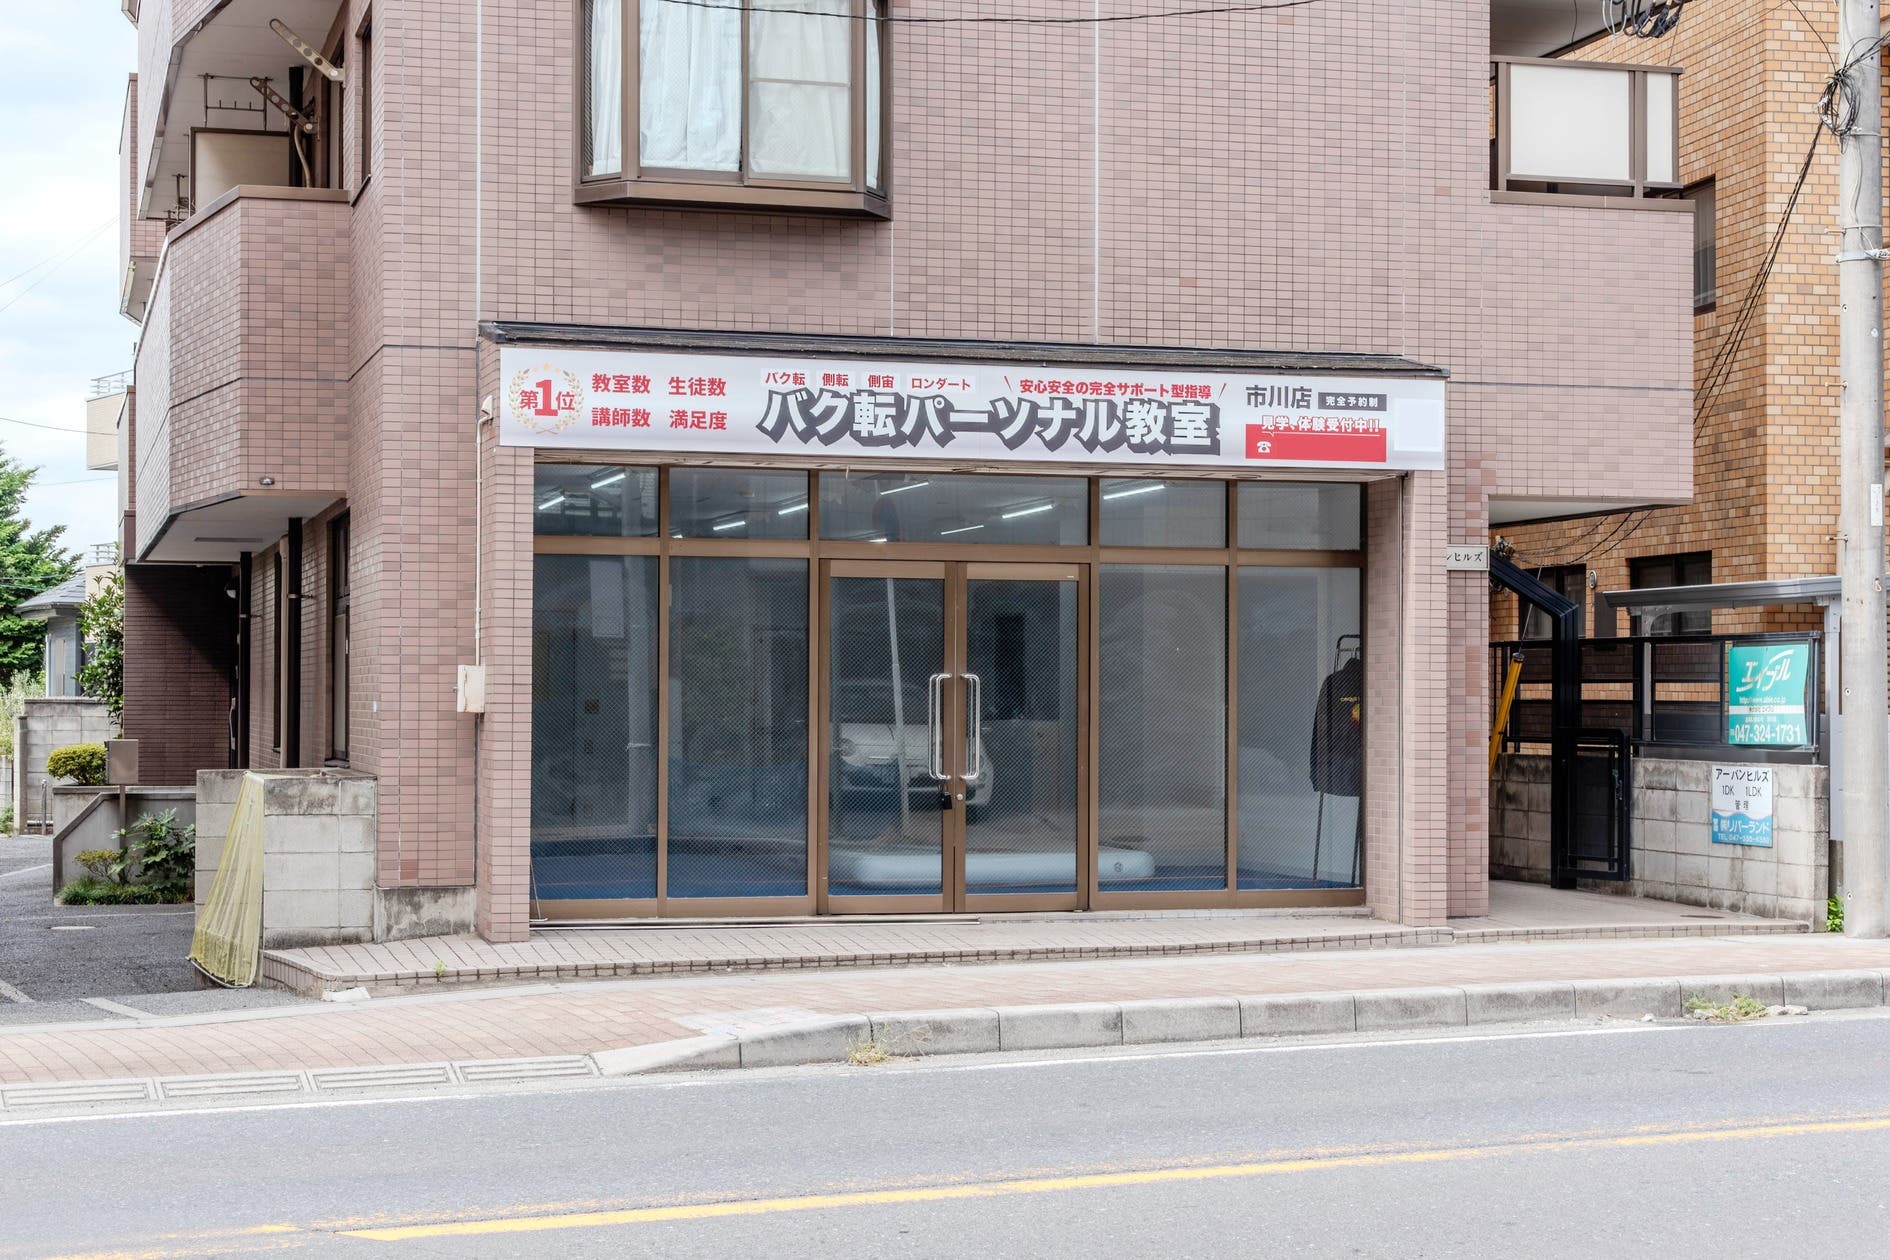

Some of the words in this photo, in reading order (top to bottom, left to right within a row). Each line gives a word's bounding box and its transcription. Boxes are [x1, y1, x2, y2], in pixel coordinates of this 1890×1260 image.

[592, 373, 651, 394] 教室数
[668, 377, 727, 397] 生徒数
[765, 372, 806, 386] バク転
[822, 373, 849, 387] 側転
[868, 375, 895, 389] 側宙
[911, 378, 971, 390] ロンダート
[1020, 379, 1212, 399] 安心安全の完全サポート型指導
[519, 379, 576, 417] 第1位
[1246, 385, 1312, 410] 市川店
[1325, 396, 1379, 408] 完全予約制
[591, 407, 651, 428] 講師数
[669, 410, 728, 430] 満足度
[756, 387, 1220, 457] バク転パーソナル教室
[1736, 649, 1795, 692] エイブル
[1715, 768, 1769, 782] アーバンヒルズ
[1722, 785, 1735, 796] 1DK
[1745, 786, 1762, 797] 1LDK
